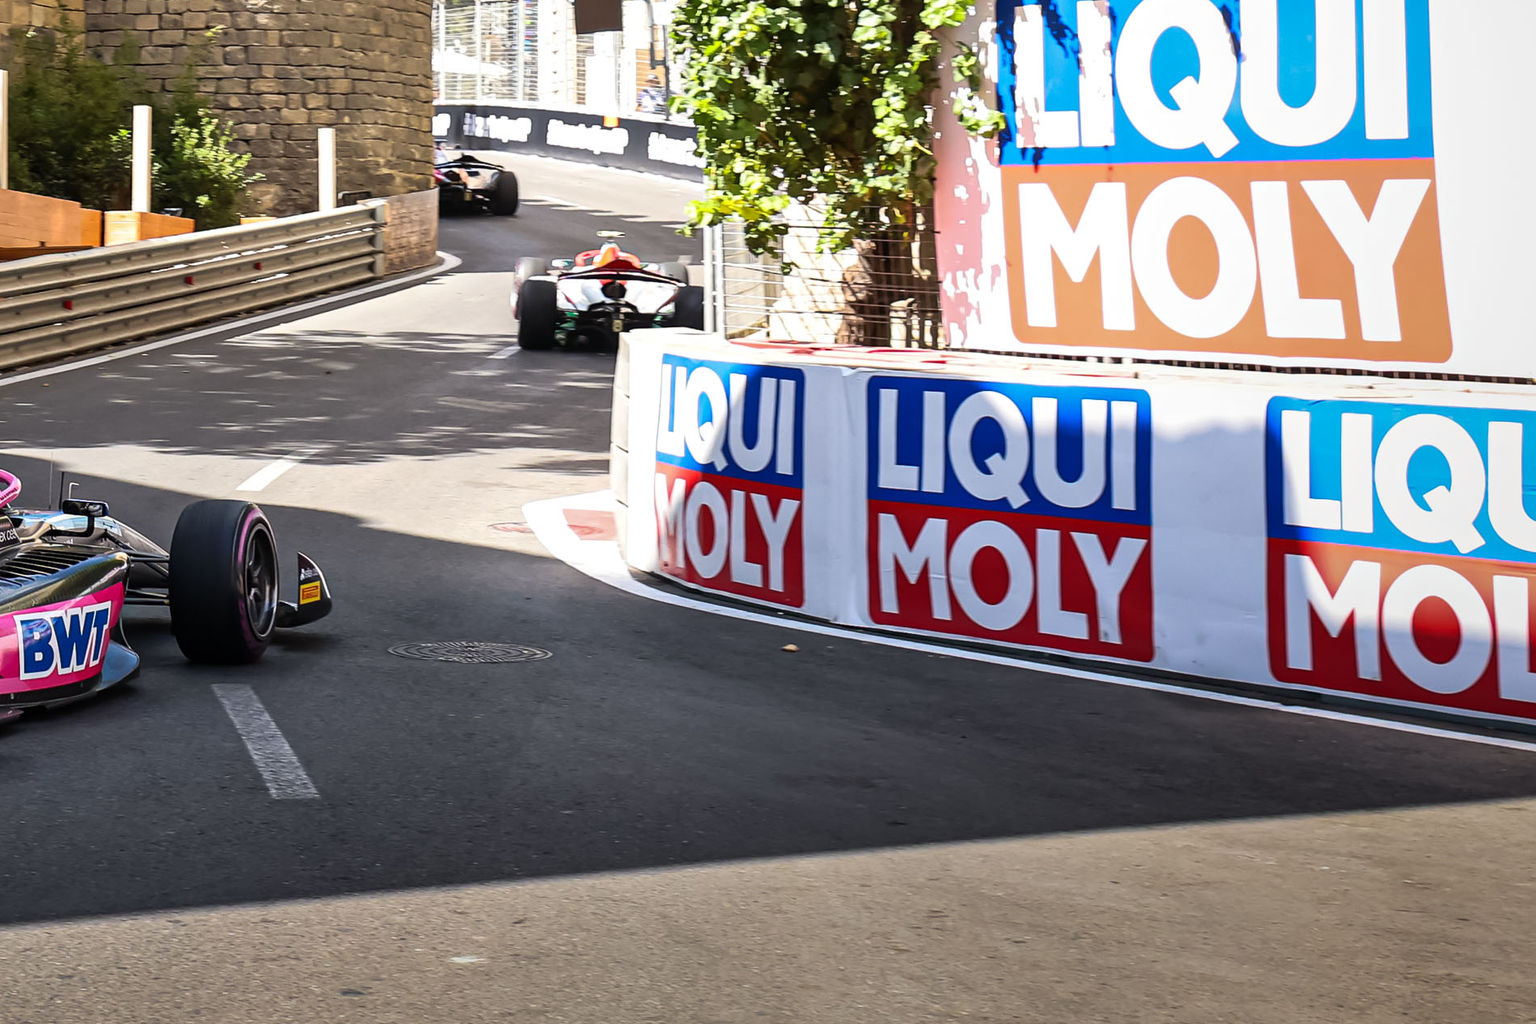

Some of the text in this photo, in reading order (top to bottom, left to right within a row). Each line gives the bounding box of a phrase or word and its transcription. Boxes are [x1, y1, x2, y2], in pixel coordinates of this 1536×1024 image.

[1018, 176, 1431, 341] MOLY
[663, 363, 796, 475] LIQUI
[878, 388, 1137, 510] LIQUI
[655, 473, 800, 592] MOLY
[878, 513, 1148, 644] MOLY
[19, 607, 110, 674] BWT
